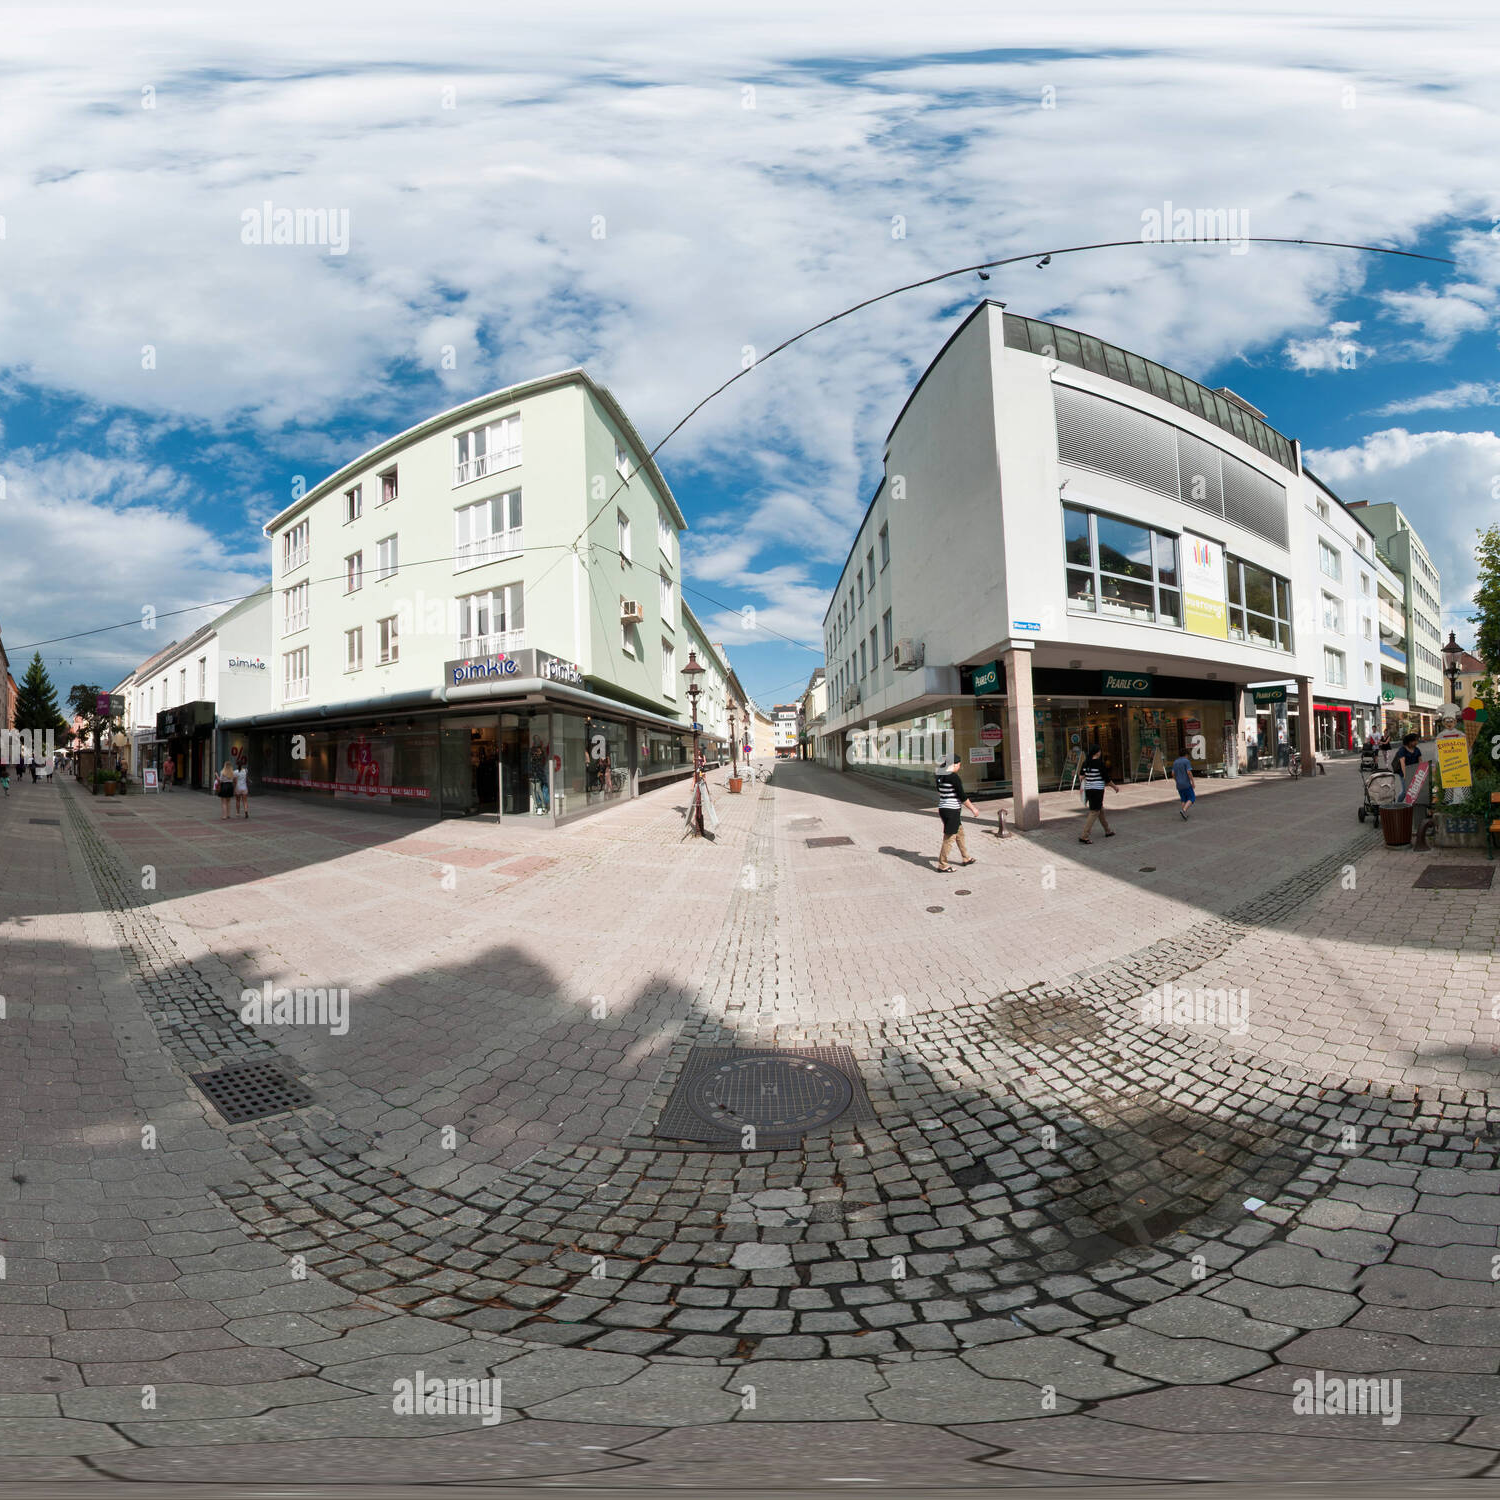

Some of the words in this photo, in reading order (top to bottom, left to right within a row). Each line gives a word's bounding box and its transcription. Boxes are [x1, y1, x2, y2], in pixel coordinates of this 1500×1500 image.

[228, 656, 266, 670] pimkie
[453, 653, 516, 685] pimkie
[549, 657, 583, 684] pimkie
